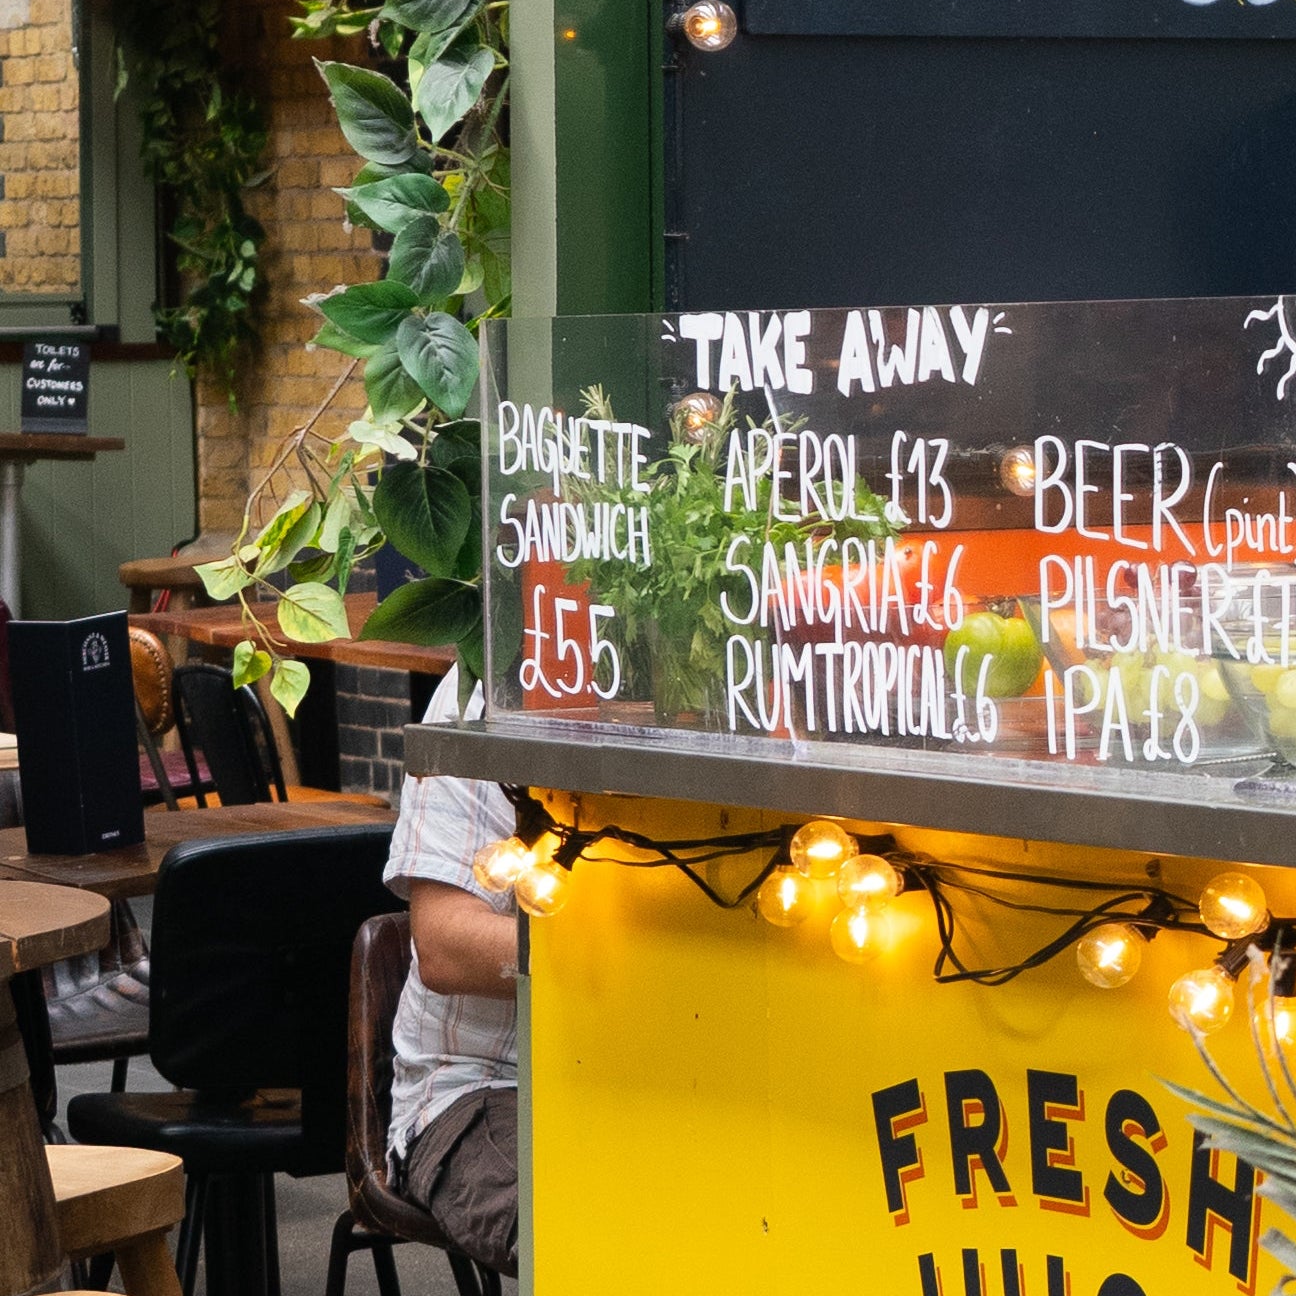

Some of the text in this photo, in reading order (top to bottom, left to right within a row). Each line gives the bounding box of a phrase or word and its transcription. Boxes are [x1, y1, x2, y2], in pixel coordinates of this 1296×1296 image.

[679, 305, 990, 397] TAKE AWAY
[497, 400, 651, 497] BAGUETTE
[724, 428, 952, 529] APEROL £13
[1034, 434, 1196, 556] BEER
[496, 493, 651, 569] SANDWICH
[720, 535, 965, 644] SANGRIA £6
[1039, 554, 1241, 660] PILSNER
[1044, 664, 1200, 764] IPA £8
